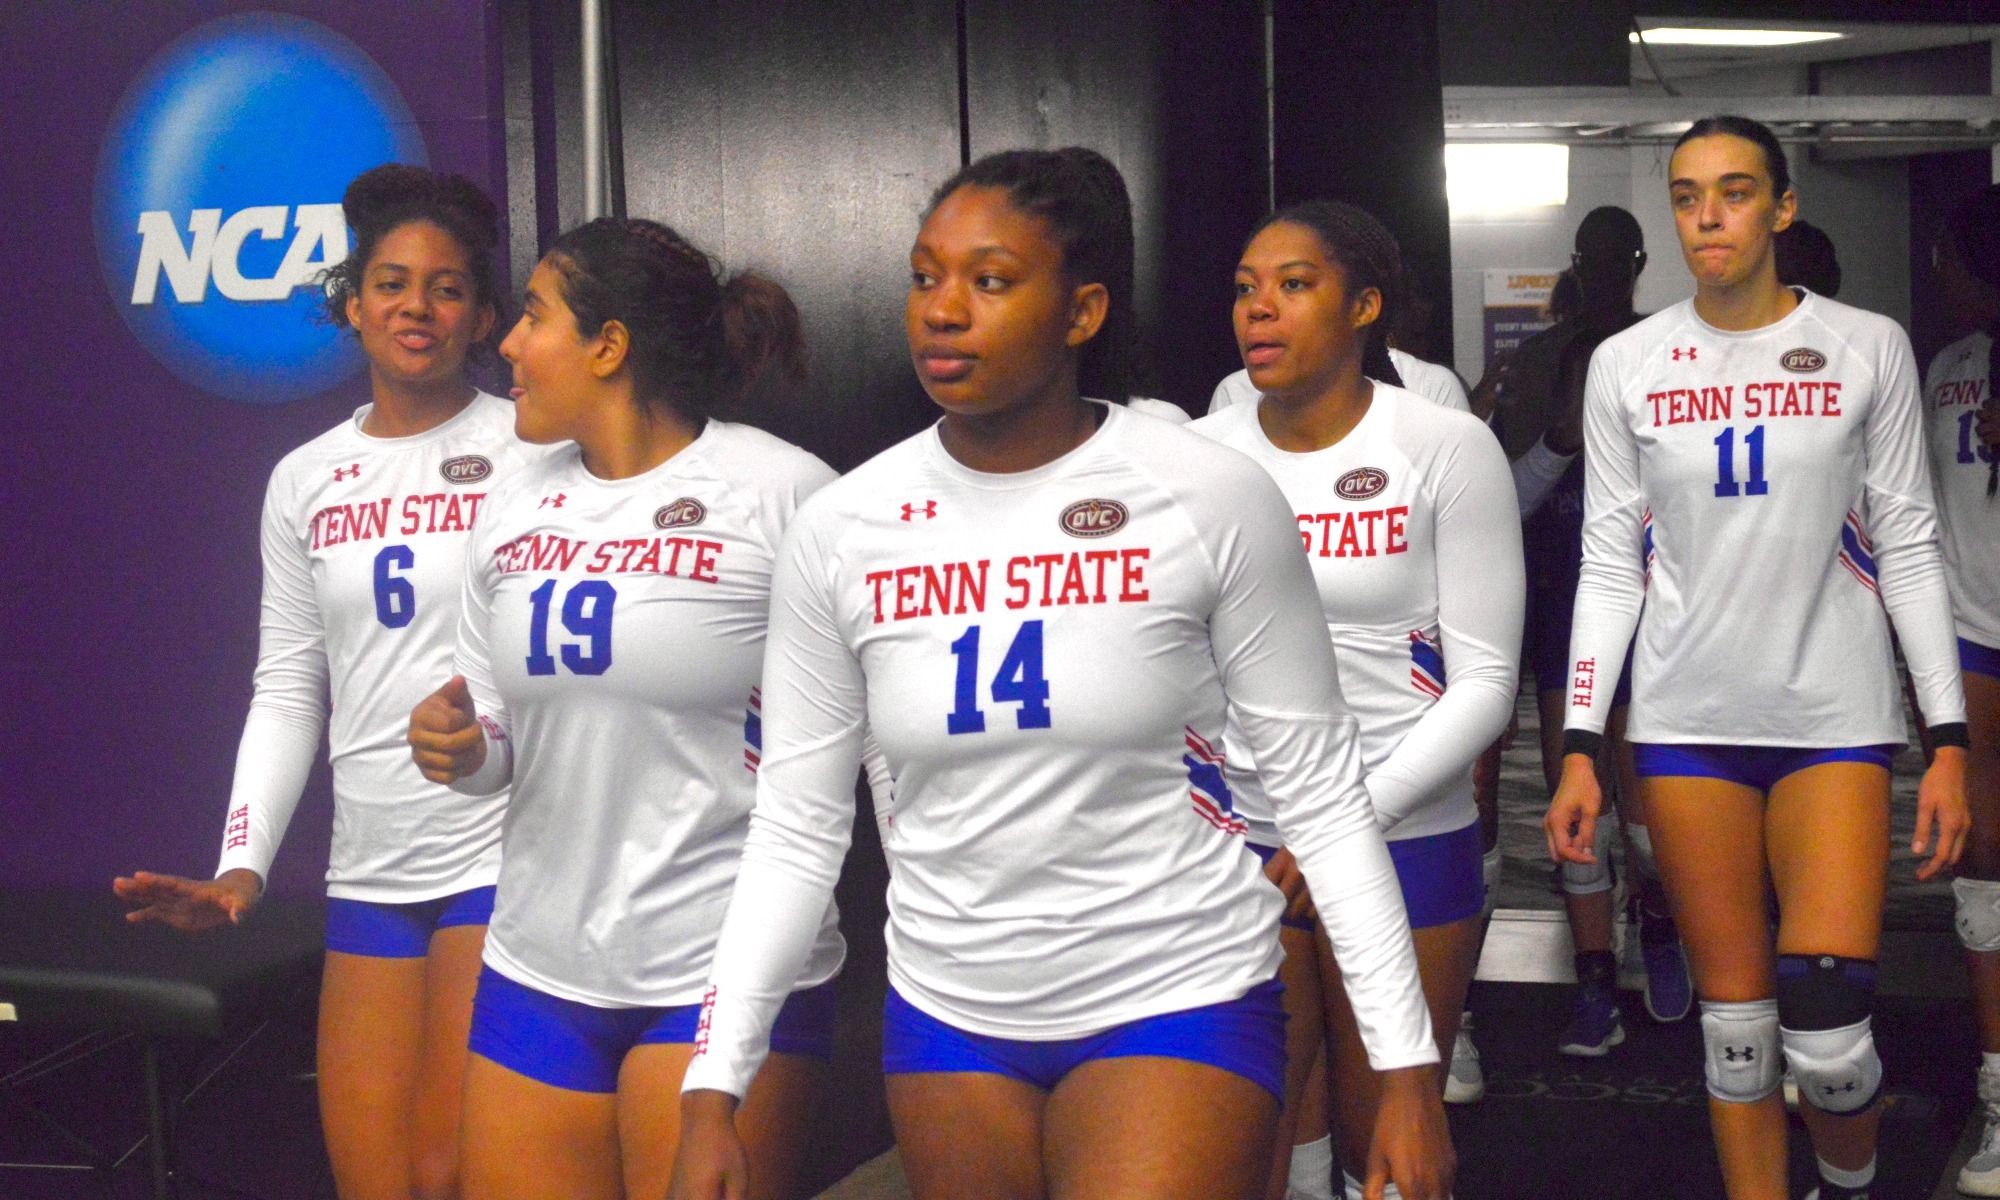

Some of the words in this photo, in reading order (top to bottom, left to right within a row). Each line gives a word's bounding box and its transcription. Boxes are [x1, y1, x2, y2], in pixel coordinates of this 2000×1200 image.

[131, 203, 349, 304] NCA
[1789, 354, 1816, 368] OVC
[1647, 385, 1733, 427] TENN
[1745, 382, 1842, 418] STATE
[450, 462, 482, 477] OVC
[1344, 476, 1378, 492] OVC
[1714, 425, 1768, 497] 11
[309, 498, 391, 551] TENN
[400, 493, 487, 536] STAT
[663, 506, 694, 525] OVC
[1072, 509, 1114, 528] OVC
[586, 537, 724, 584] STATE
[373, 544, 415, 629] 6
[866, 559, 990, 624] TENN
[1005, 548, 1150, 610] STATE
[525, 578, 617, 676] 19
[947, 619, 1051, 735] 14
[1573, 657, 1595, 708] H.E.R.
[227, 803, 249, 851] H.E.R.
